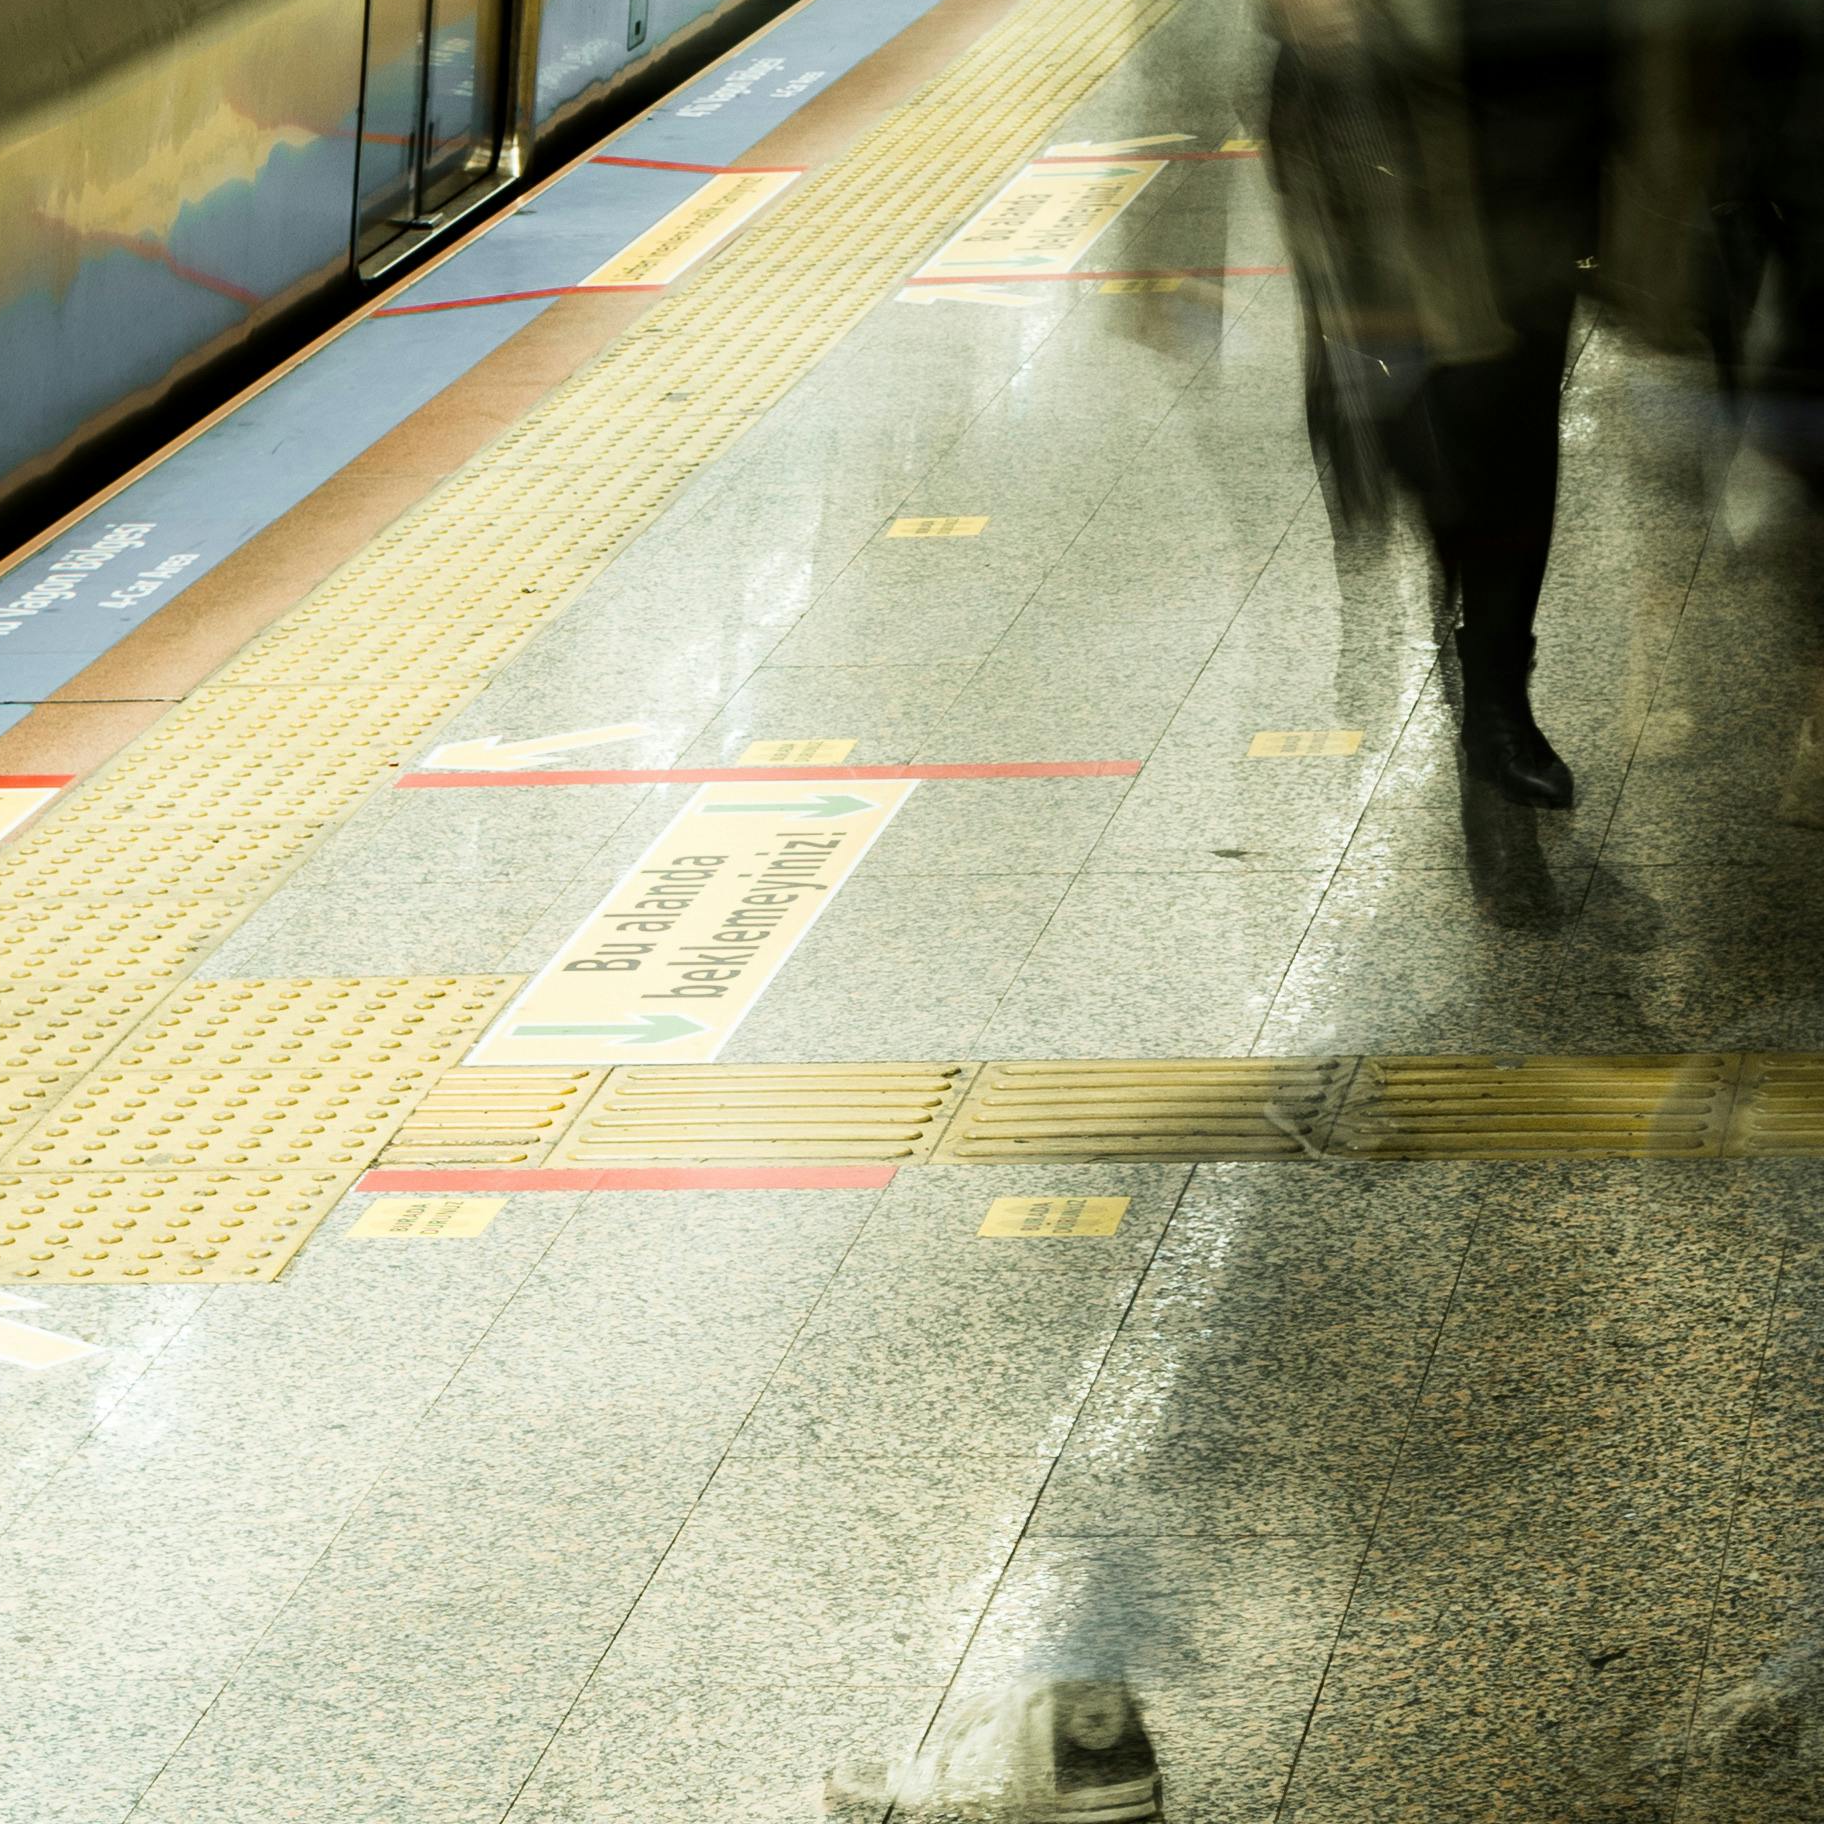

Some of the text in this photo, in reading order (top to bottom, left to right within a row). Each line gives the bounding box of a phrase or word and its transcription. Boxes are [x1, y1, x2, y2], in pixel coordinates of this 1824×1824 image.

[962, 193, 1053, 242] Bu alanda
[49, 522, 157, 571] Bölgesi
[137, 553, 201, 579] Area
[562, 855, 729, 972] Bu alanda
[640, 832, 847, 999] beklemeyiniz!
[389, 1203, 430, 1231] BURADA
